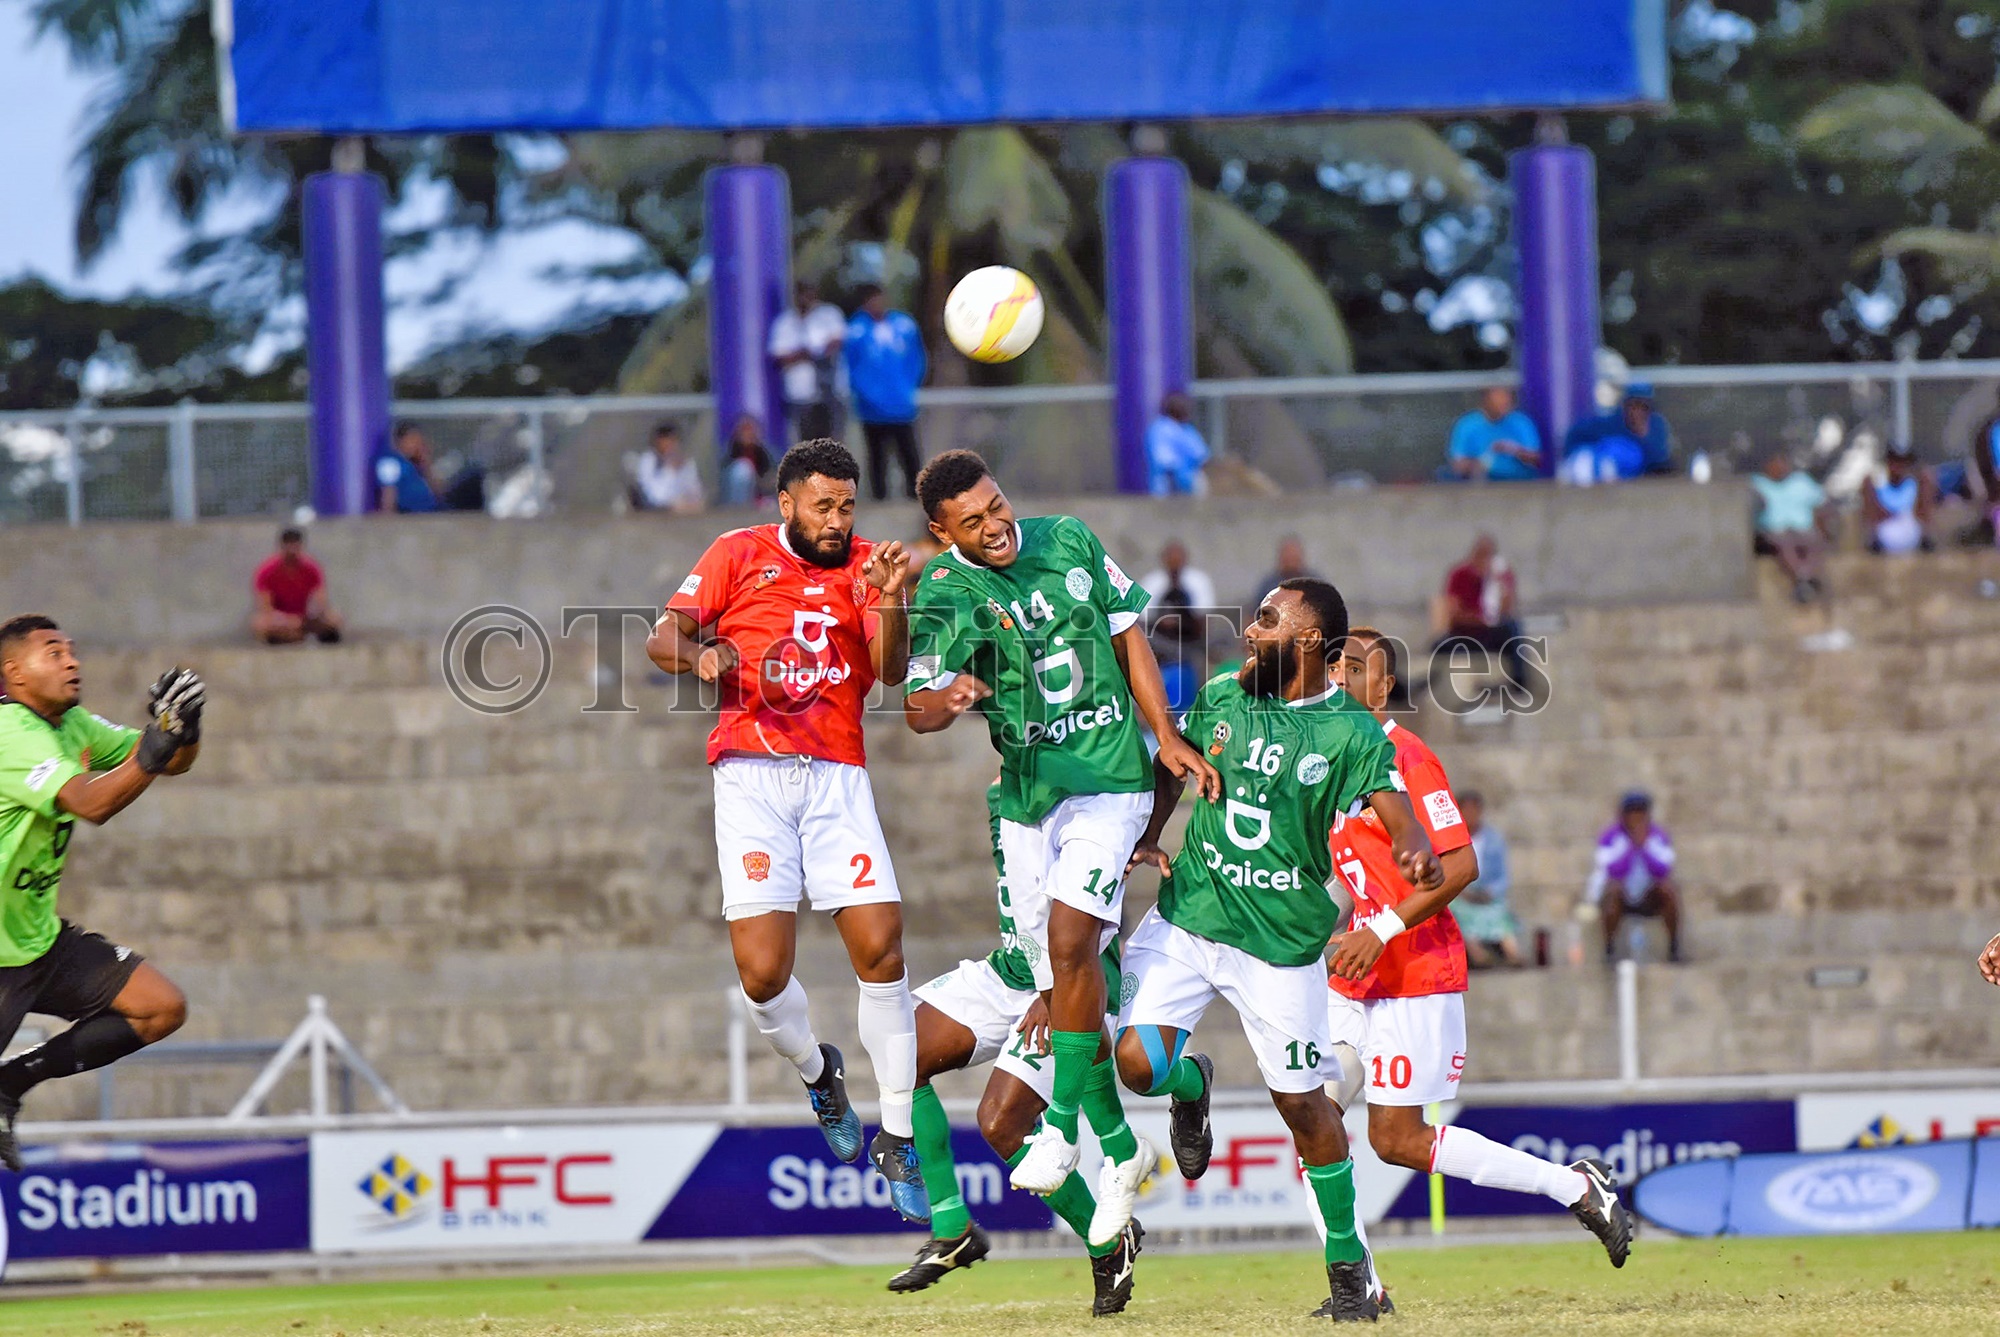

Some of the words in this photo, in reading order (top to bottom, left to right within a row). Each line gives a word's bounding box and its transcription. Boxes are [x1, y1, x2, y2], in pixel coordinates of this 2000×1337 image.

[1010, 589, 1056, 631] 14
[1023, 694, 1124, 747] Dgicel
[1242, 737, 1285, 776] 16
[850, 853, 876, 889] 2
[1082, 867, 1119, 906] 14
[1202, 840, 1303, 892] Dgicel
[1285, 1040, 1322, 1070] 16
[1371, 1055, 1412, 1090] 10
[18, 1168, 258, 1231] Stadium
[441, 1153, 614, 1211] HFC
[767, 1152, 1004, 1211] Stadm
